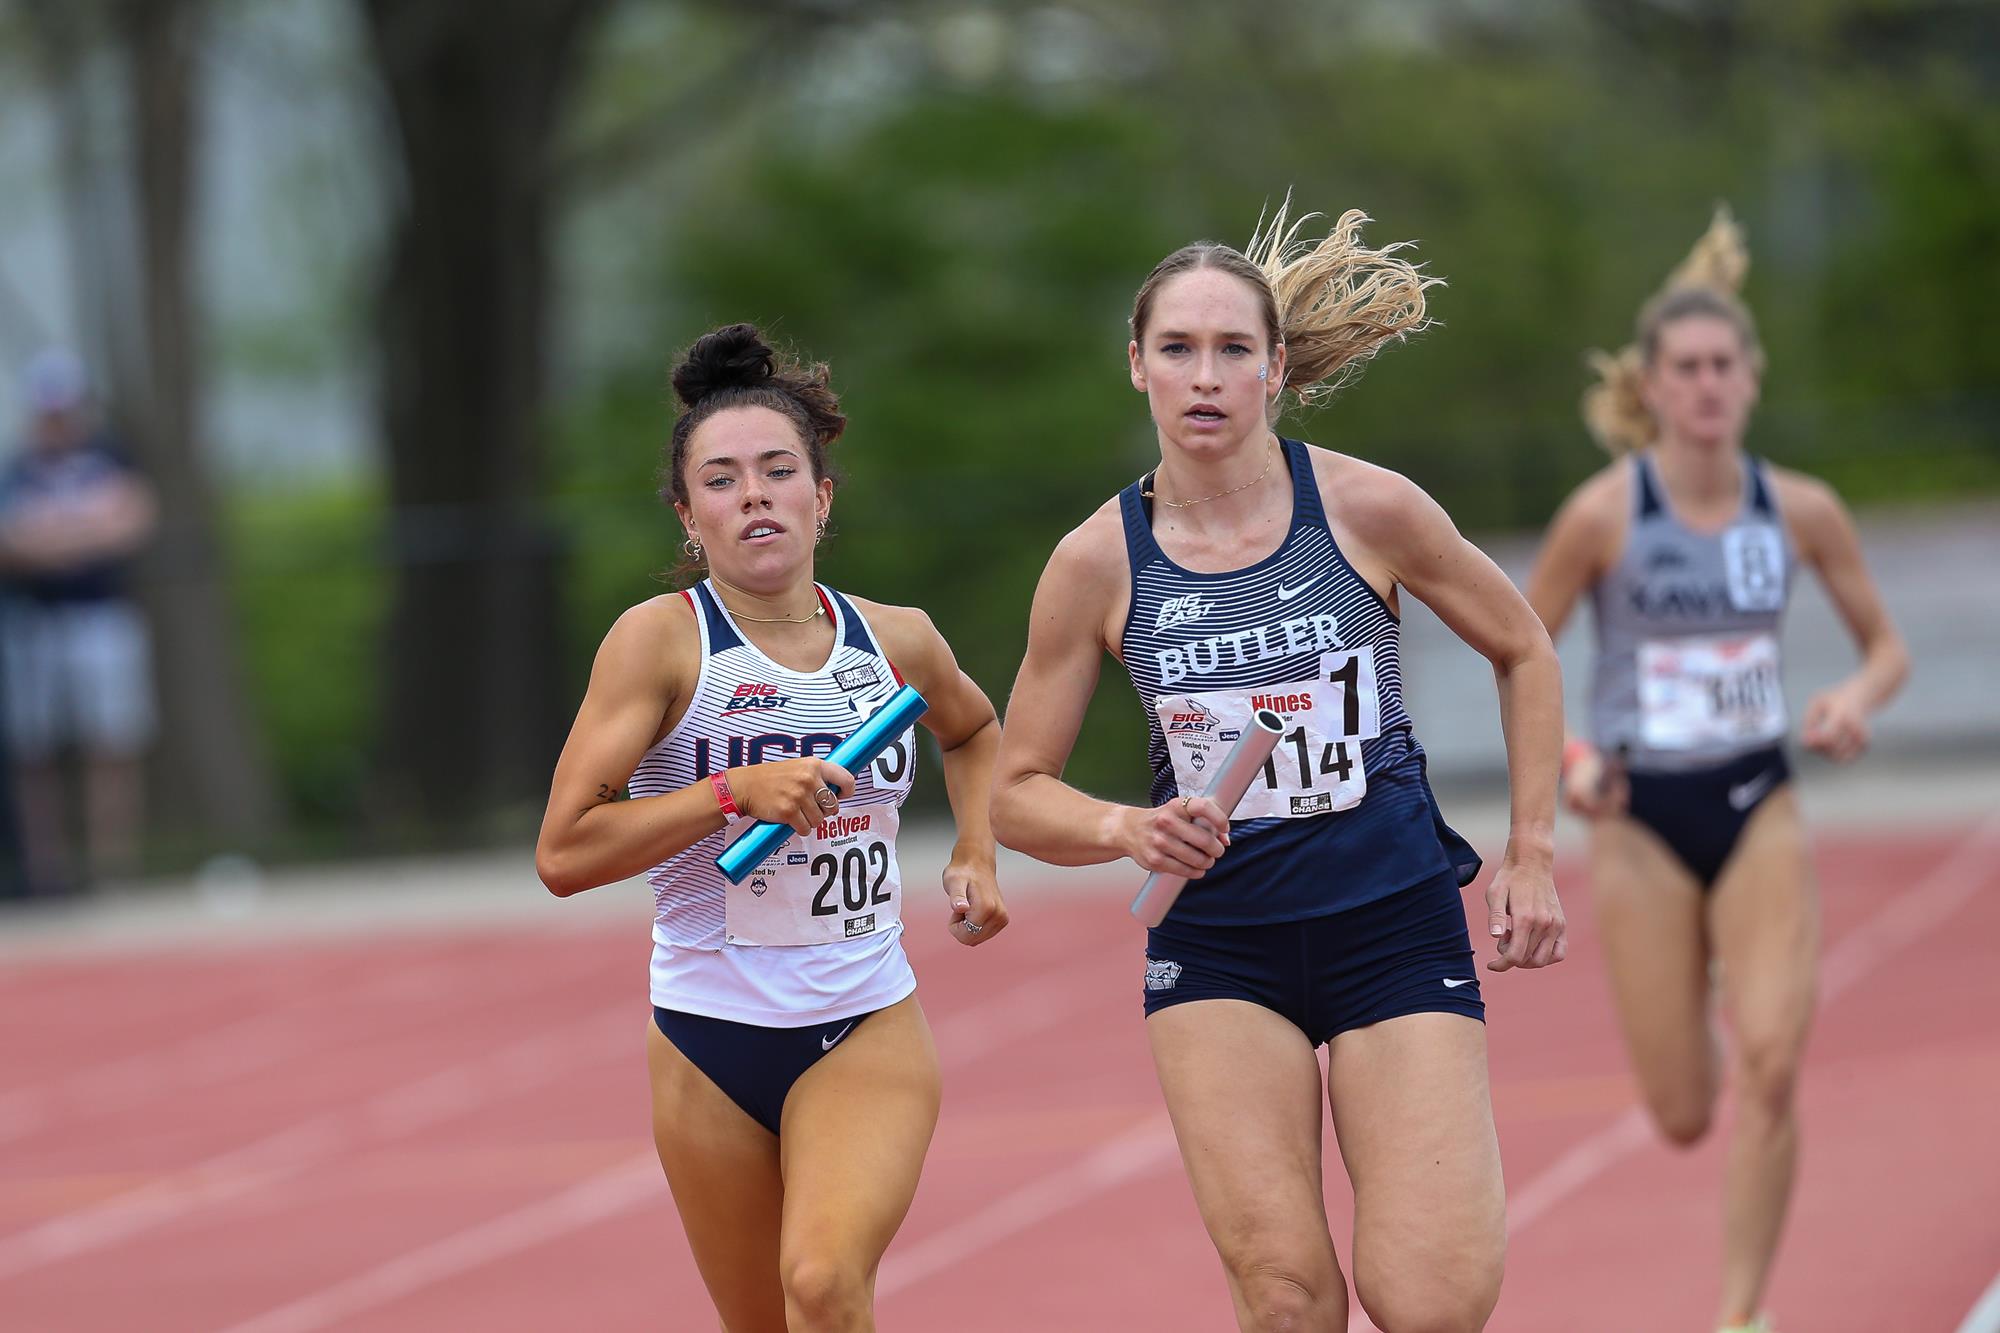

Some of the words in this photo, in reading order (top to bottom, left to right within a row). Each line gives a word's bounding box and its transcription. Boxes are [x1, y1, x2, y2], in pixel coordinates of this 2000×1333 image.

[1161, 592, 1203, 612] BIG
[1155, 602, 1216, 628] EAST
[1156, 614, 1345, 686] BUTLER
[841, 674, 878, 690] CHANGE
[734, 684, 779, 697] BIG
[1330, 655, 1360, 737] 1
[725, 696, 791, 711] EAST
[1251, 693, 1313, 713] Hines
[1172, 713, 1206, 722] BIG
[1168, 722, 1215, 732] EAST
[1181, 740, 1202, 749] Hosted
[1202, 743, 1211, 752] by
[1292, 802, 1330, 814] CHANGE
[816, 814, 871, 840] Relyea
[767, 869, 776, 877] by
[810, 841, 892, 917] 202
[846, 923, 874, 936] CHANGE
